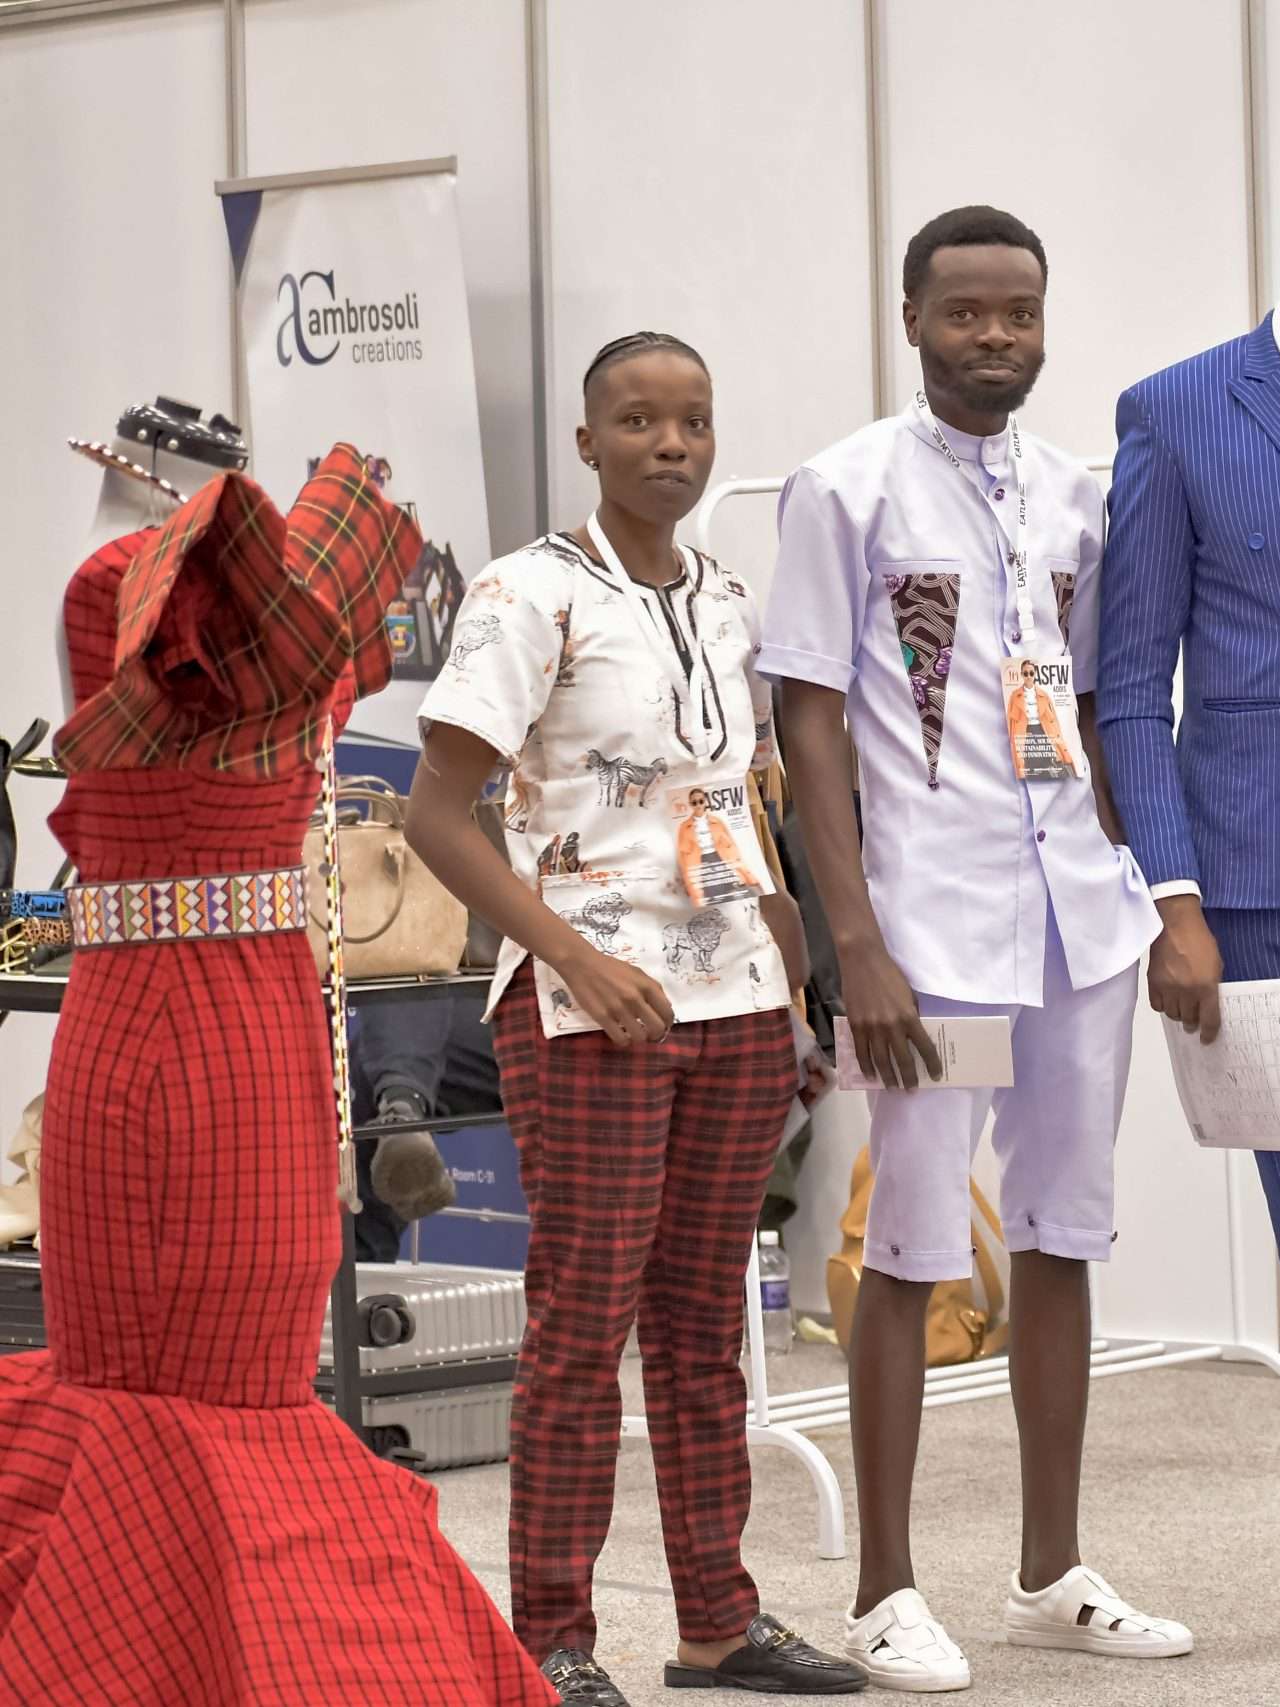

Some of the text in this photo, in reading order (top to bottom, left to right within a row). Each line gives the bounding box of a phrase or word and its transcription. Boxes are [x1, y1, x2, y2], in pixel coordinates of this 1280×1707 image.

[307, 293, 420, 337] ambrosoli
[351, 336, 423, 364] creations
[1034, 664, 1069, 686] ASFW
[704, 785, 744, 812] ASFW
